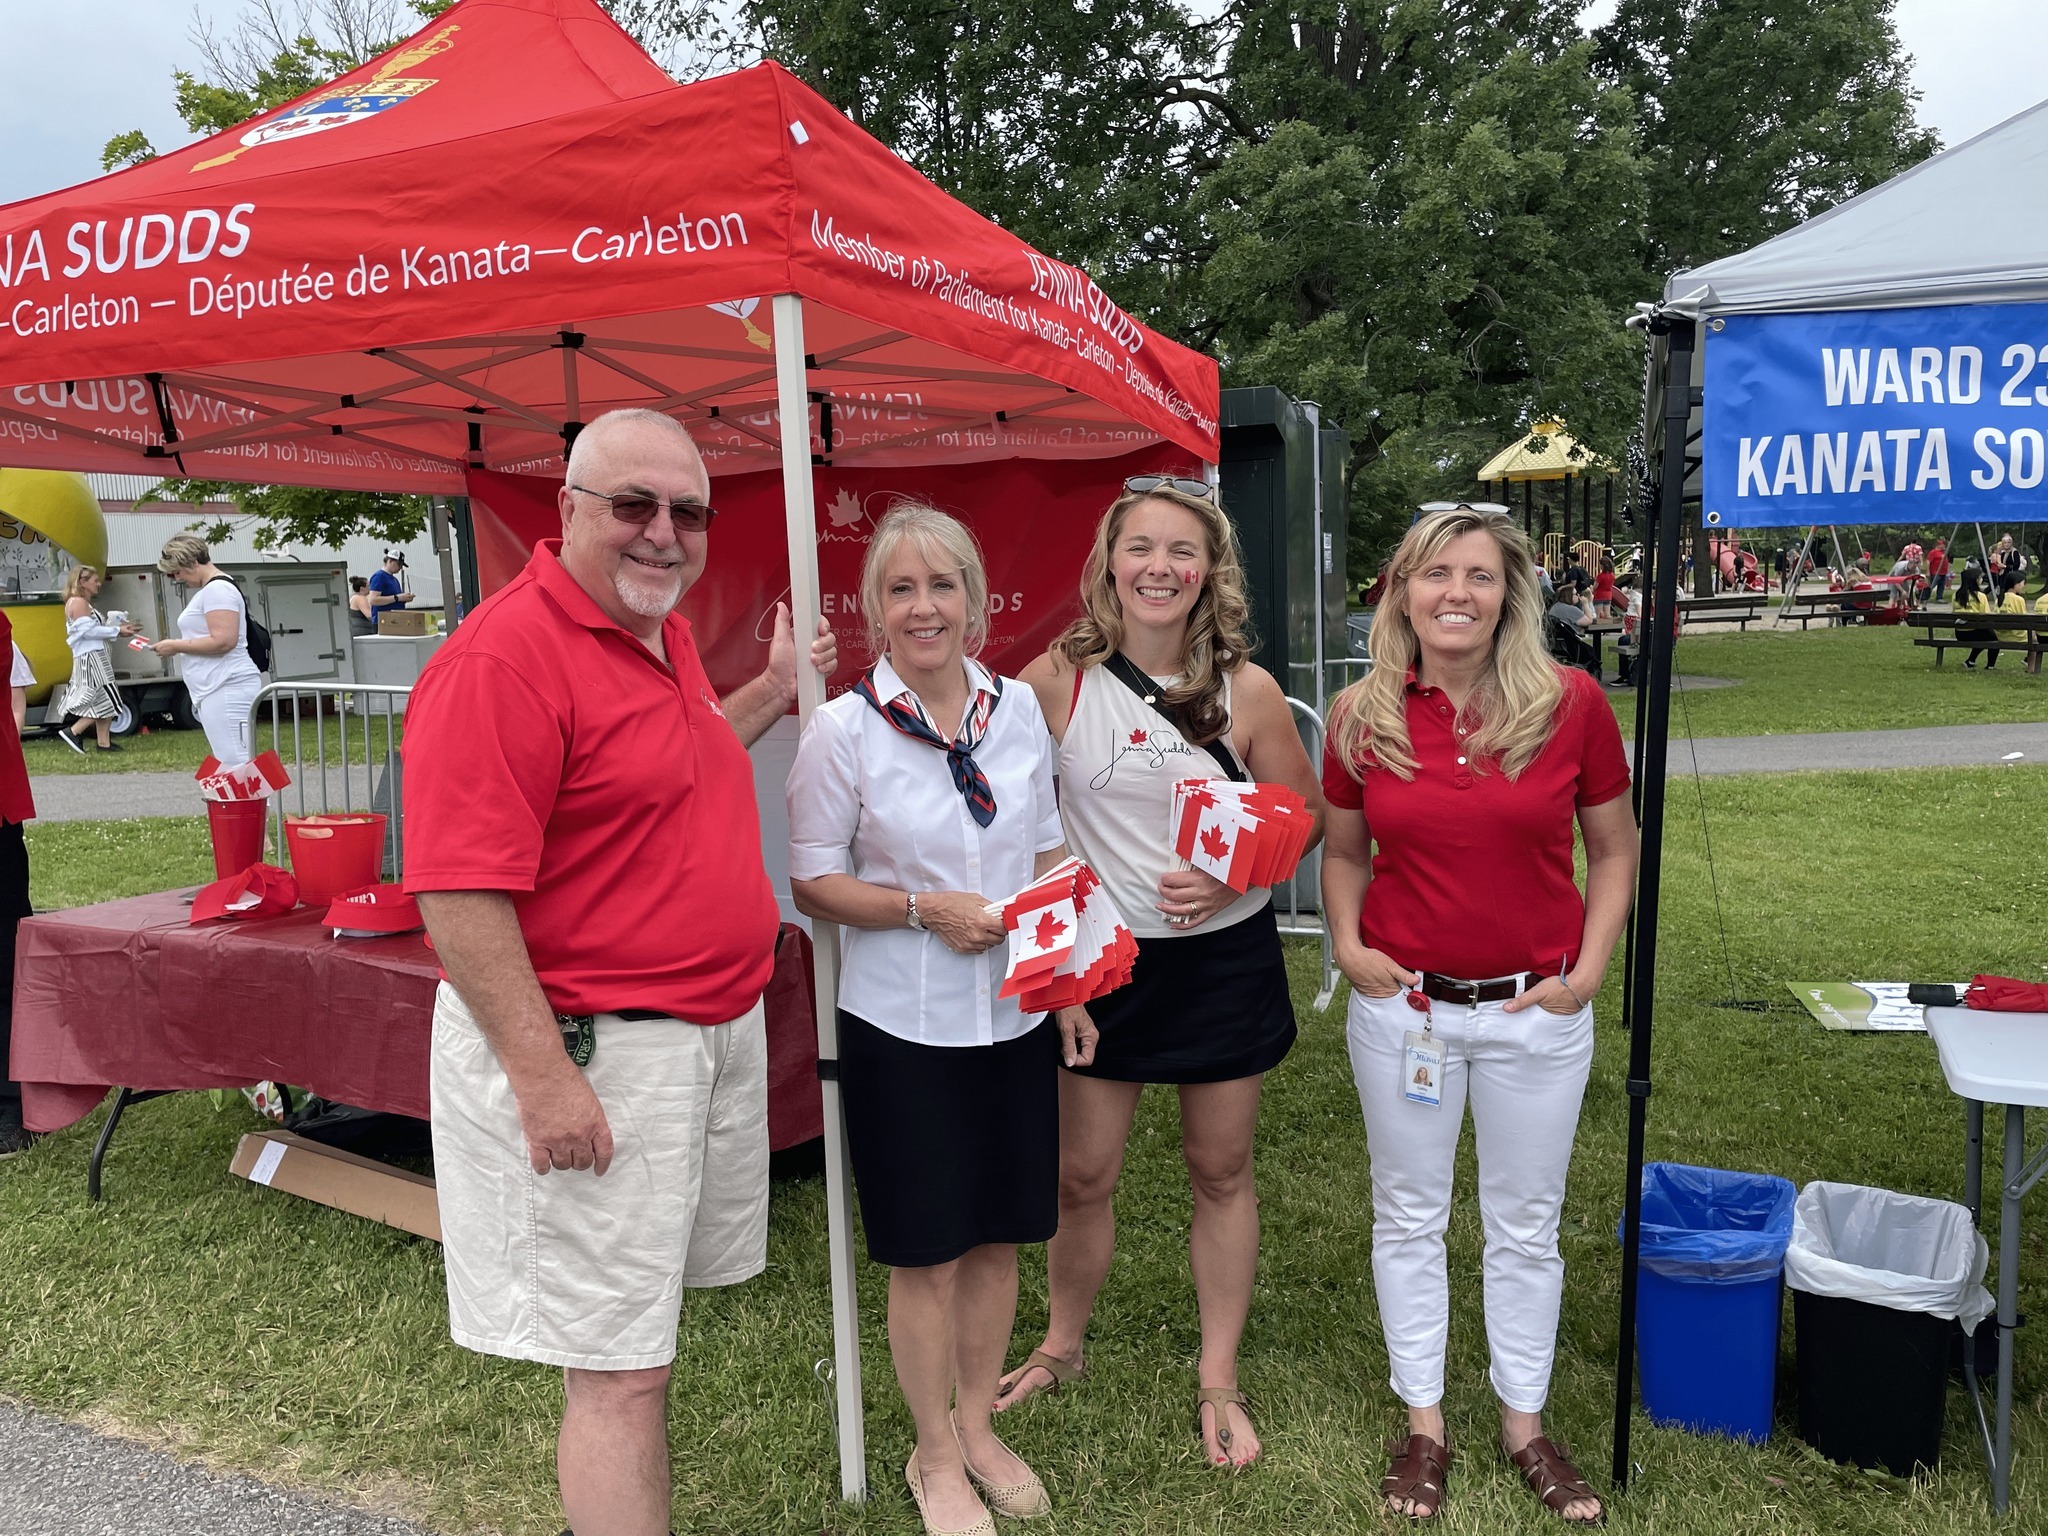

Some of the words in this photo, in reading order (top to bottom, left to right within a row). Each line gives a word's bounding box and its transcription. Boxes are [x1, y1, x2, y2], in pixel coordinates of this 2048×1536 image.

[62, 203, 255, 279] SUDDS
[811, 209, 905, 281] Member
[911, 255, 931, 290] of
[930, 260, 1009, 325] Parliament
[1008, 295, 1030, 333] for
[189, 263, 334, 319] Députée
[346, 254, 389, 297] de
[1022, 249, 1087, 318] JENNA
[1822, 345, 1982, 407] WARD
[1737, 428, 1952, 497] KANATA
[1970, 427, 2048, 490] SO
[1149, 729, 1198, 769] Sudds
